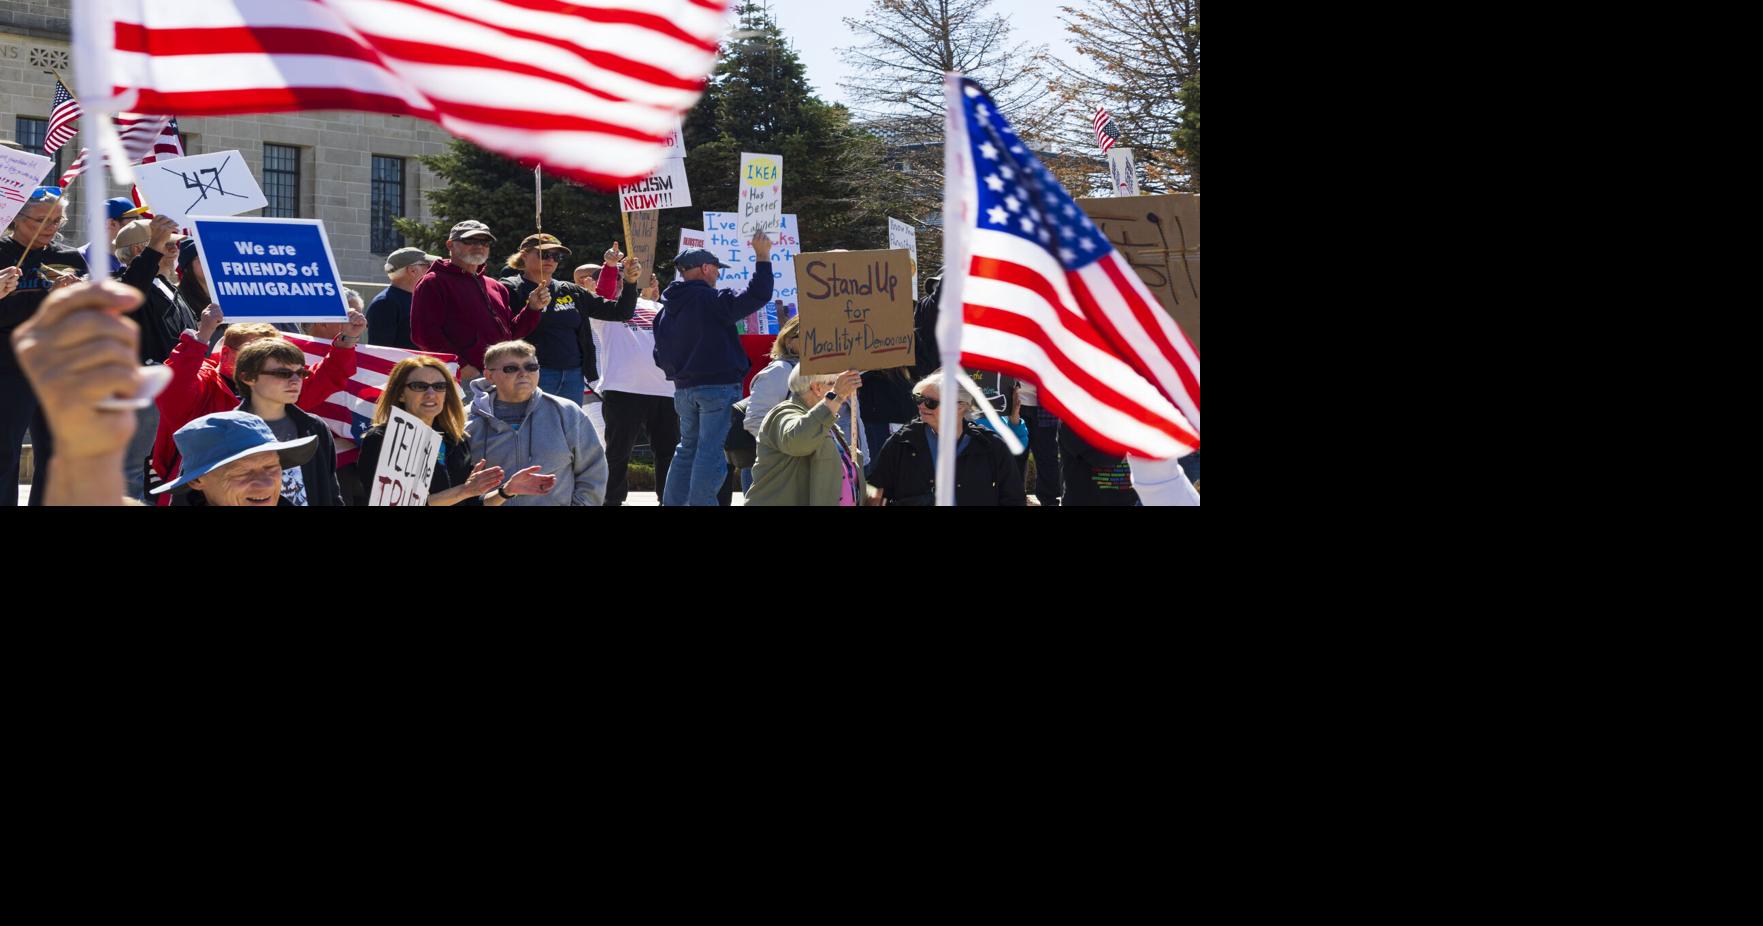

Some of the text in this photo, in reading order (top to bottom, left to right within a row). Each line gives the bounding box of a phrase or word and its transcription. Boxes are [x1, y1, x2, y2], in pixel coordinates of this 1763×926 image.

[747, 164, 777, 180] IKEA
[181, 167, 224, 199] 47
[749, 187, 764, 200] Has
[623, 193, 673, 211] NOW!!!
[745, 201, 777, 217] Better
[705, 213, 736, 230] I've
[711, 233, 739, 247] the
[234, 241, 296, 256] We are
[728, 249, 741, 262] I
[221, 262, 319, 276] FRIENDS of
[217, 282, 336, 296] IMMIGRANTS
[806, 261, 897, 301] Stand Up
[844, 300, 870, 319] for
